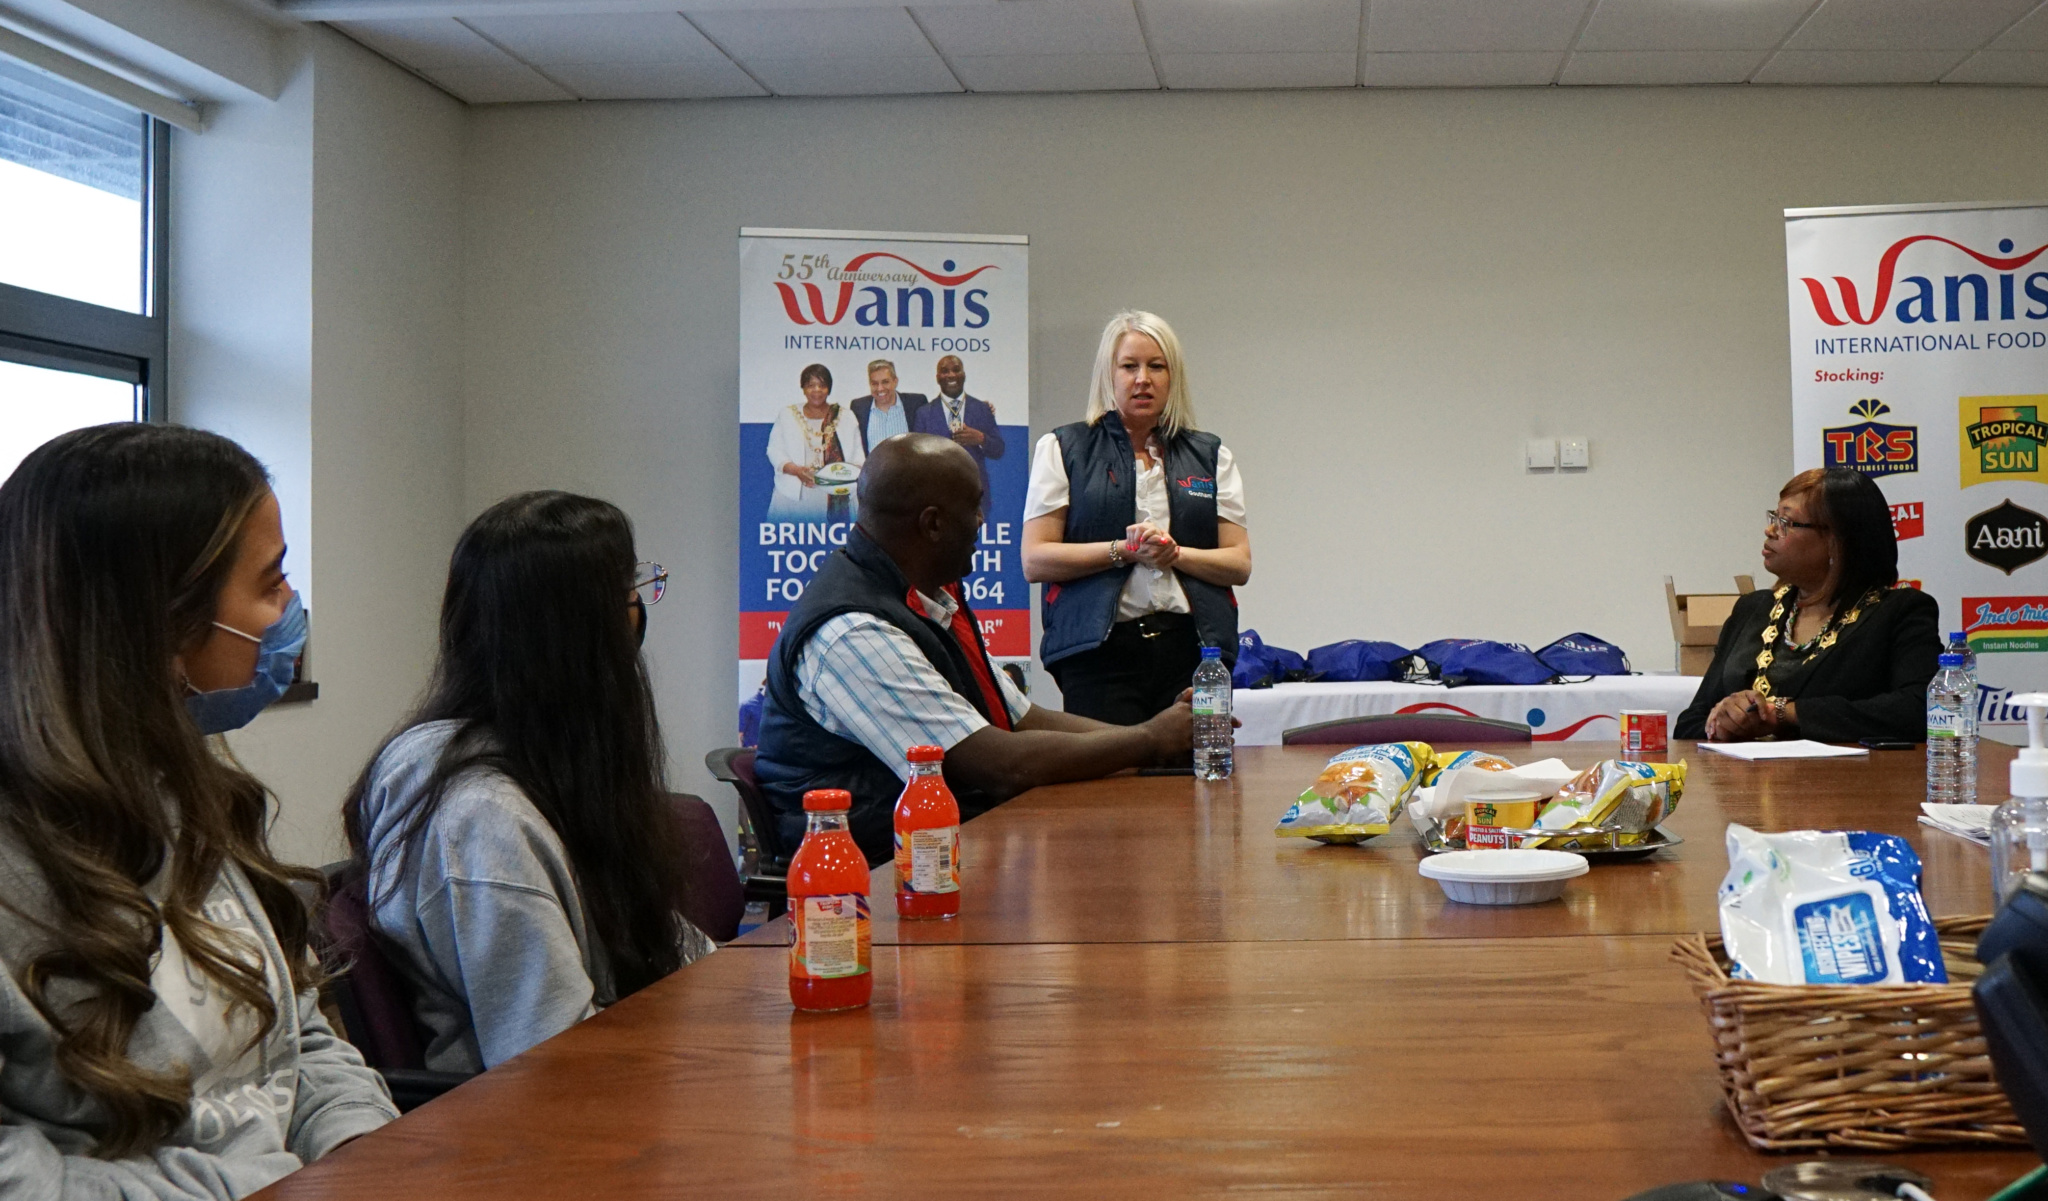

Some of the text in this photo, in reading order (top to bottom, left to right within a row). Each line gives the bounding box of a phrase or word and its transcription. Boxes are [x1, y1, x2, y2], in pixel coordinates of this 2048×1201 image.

[777, 253, 830, 280] 55th
[826, 265, 918, 287] Anniversary
[773, 252, 1001, 329] Wanis
[1799, 234, 2048, 326] Wanis
[784, 335, 991, 352] INTERNATIONAL FOODS
[1814, 333, 1980, 355] INTERNATIONAL
[1814, 368, 1884, 384] Stocking:
[1971, 422, 2045, 442] TROPICAL
[1826, 427, 1914, 463] TRS
[1857, 464, 1885, 472] FINEST
[1889, 463, 1915, 472] FOODS
[1985, 451, 2033, 470] SUN
[758, 522, 848, 546] BRING
[1972, 520, 2045, 549] Aani
[962, 577, 1005, 604] 964
[1983, 640, 2039, 650] Instant Noodles
[1477, 817, 1492, 825] SUN
[1469, 832, 1505, 845] PEANUTS
[1830, 933, 1871, 980] WIPES
